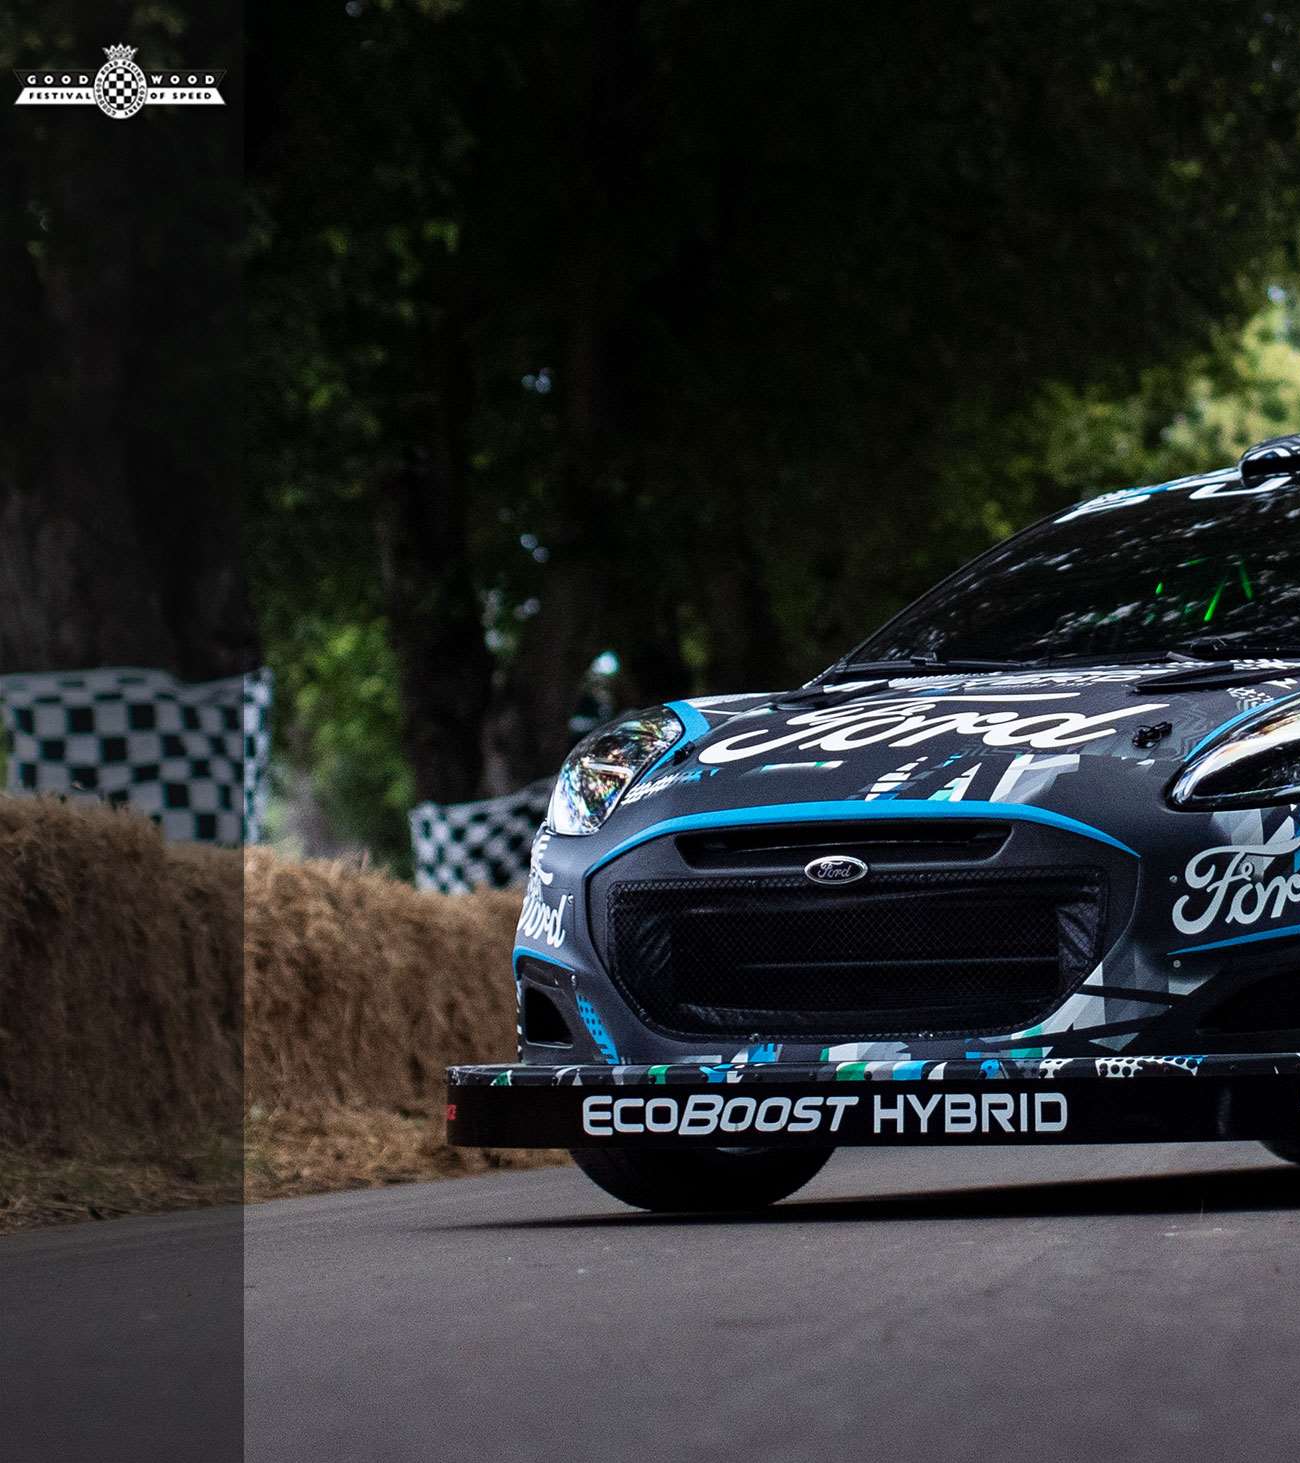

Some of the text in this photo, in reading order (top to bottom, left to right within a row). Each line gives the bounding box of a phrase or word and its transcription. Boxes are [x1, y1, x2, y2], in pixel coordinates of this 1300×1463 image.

[699, 692, 1170, 764] Ford
[818, 860, 852, 878] Ford
[874, 1093, 1068, 1134] HYBRID
